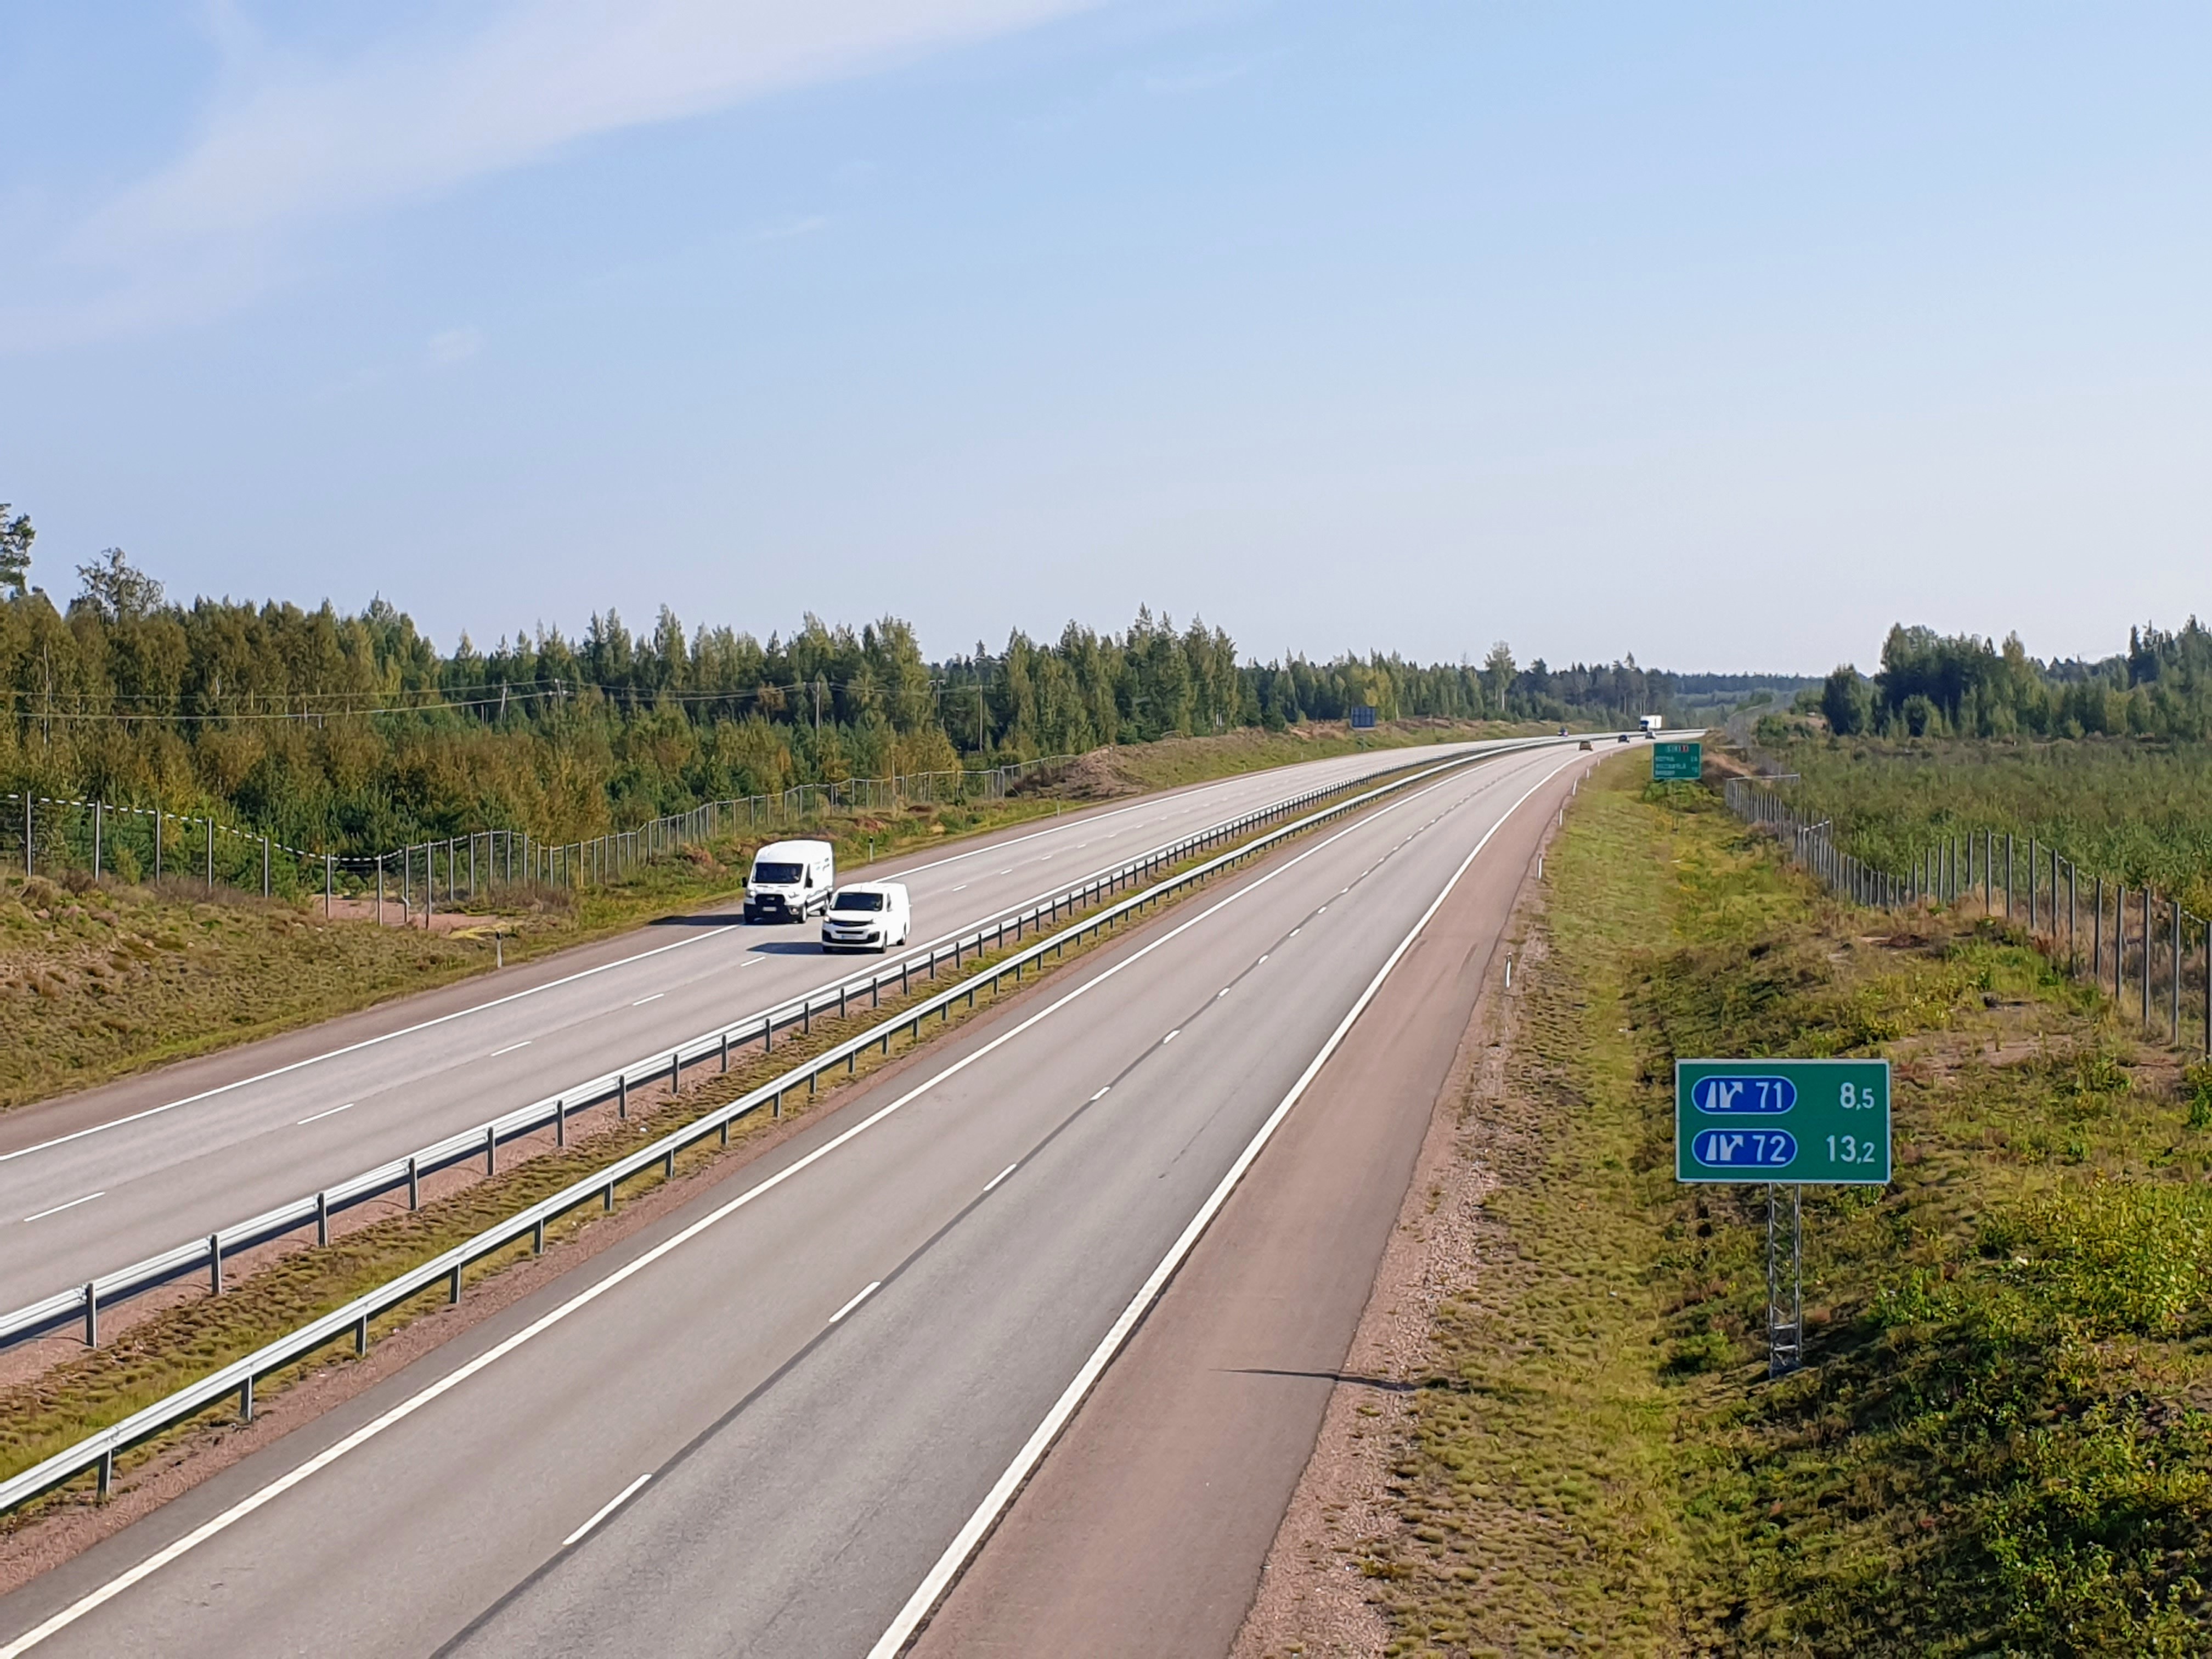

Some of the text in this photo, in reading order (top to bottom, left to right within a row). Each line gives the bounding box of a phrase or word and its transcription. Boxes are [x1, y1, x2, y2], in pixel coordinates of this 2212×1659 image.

[1756, 1082, 1875, 1110] 71 8,5
[1752, 1135, 1875, 1164] 72 13,2
